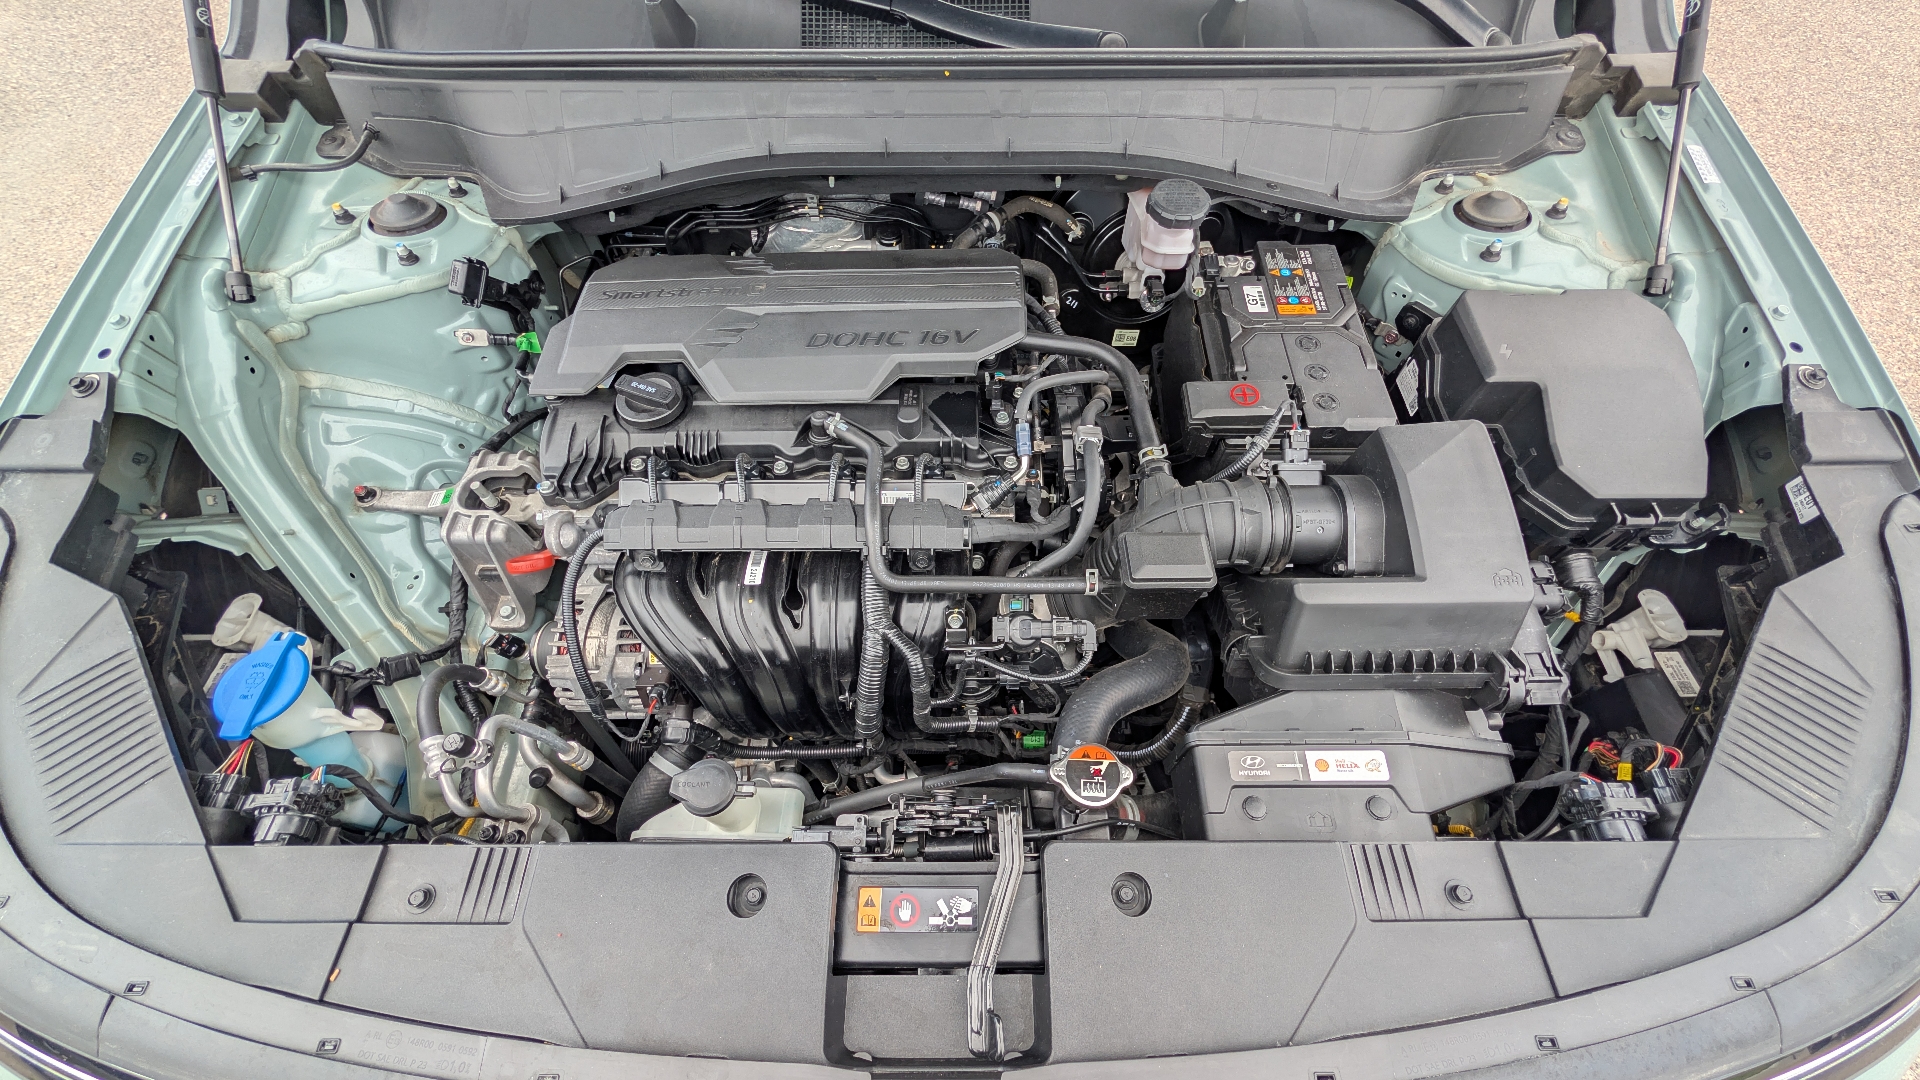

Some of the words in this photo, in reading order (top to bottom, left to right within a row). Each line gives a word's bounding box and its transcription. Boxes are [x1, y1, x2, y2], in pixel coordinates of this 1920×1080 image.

[602, 285, 742, 300] Smartstream
[1246, 293, 1258, 306] G7
[804, 331, 912, 349] DOHC
[918, 328, 981, 347] 16V
[251, 661, 275, 669] WASHER
[459, 1046, 478, 1057] 0592
[358, 1049, 375, 1060] DOT
[377, 1052, 391, 1064] SAE
[393, 1056, 408, 1067] DRL
[409, 1059, 417, 1068] P
[416, 1060, 428, 1070] 23
[1405, 1063, 1423, 1075] DOT
[1426, 1060, 1441, 1072] SAE
[1442, 1058, 1458, 1069] DRL
